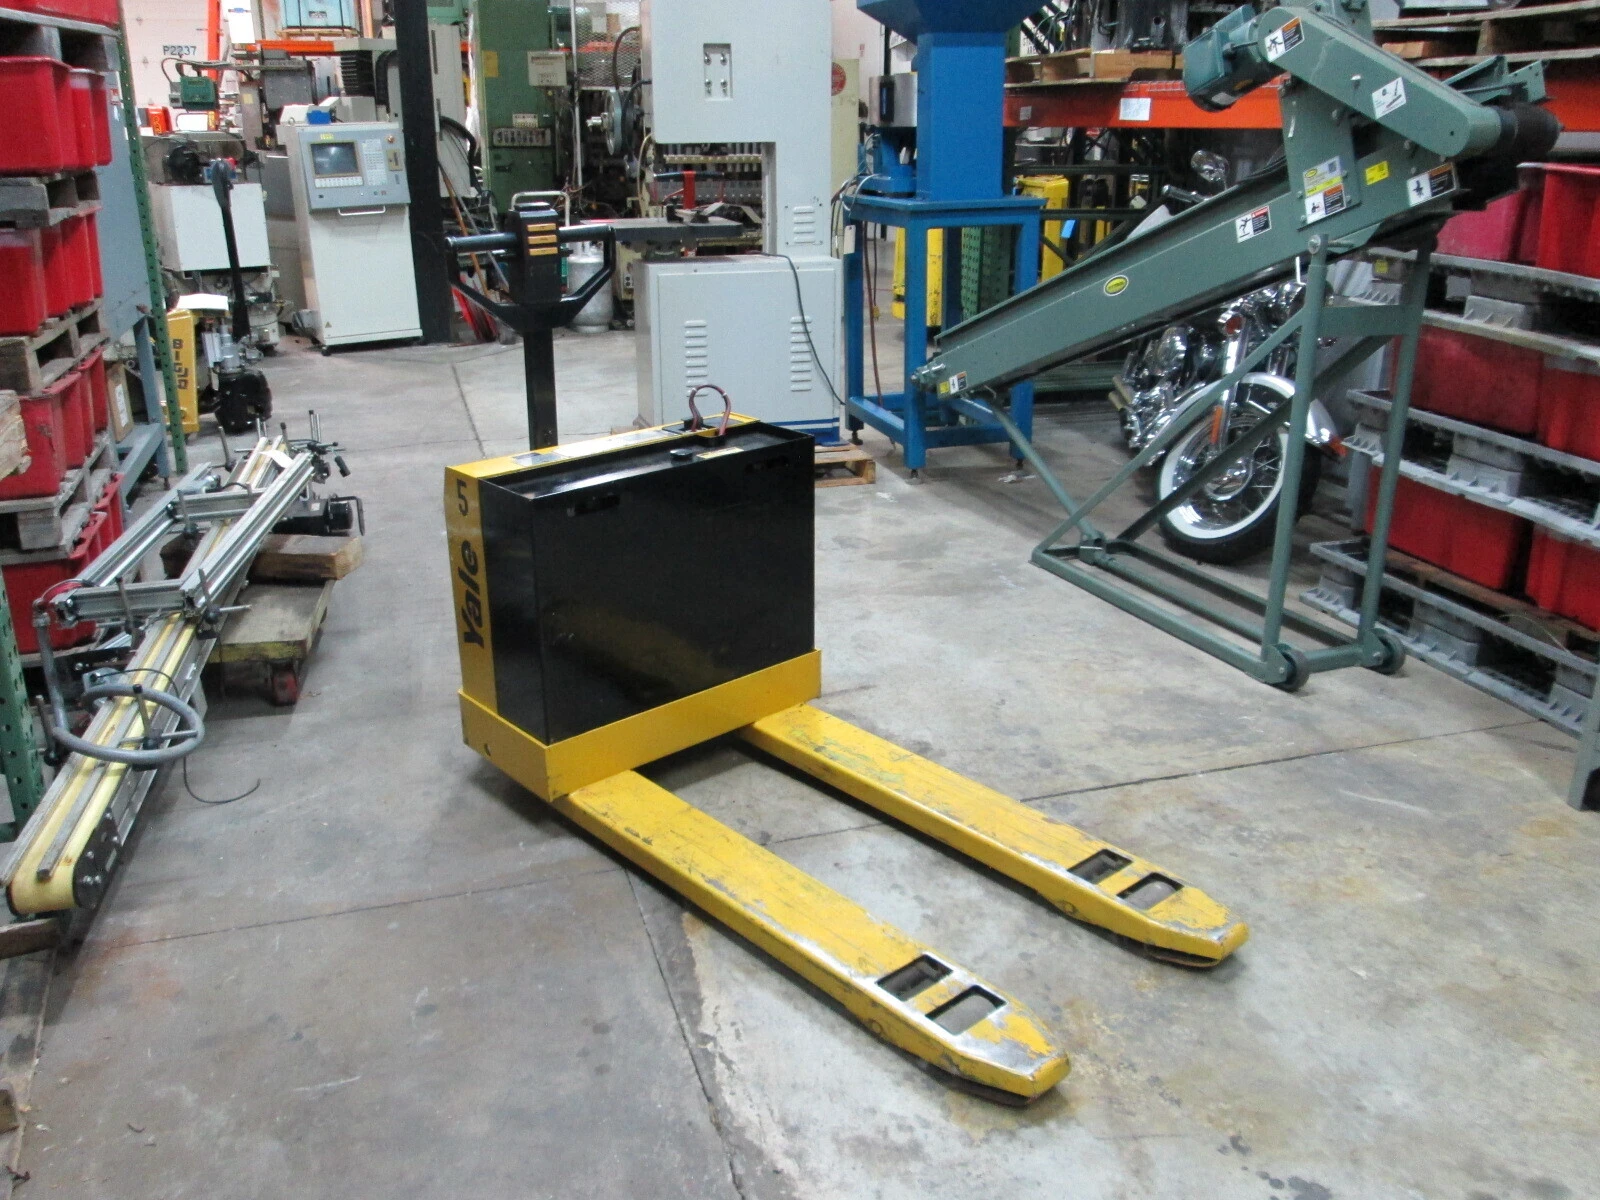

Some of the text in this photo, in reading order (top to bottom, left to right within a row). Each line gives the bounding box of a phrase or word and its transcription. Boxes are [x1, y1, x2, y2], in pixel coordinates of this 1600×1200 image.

[163, 45, 197, 56] P2237
[456, 478, 469, 517] 5
[457, 540, 485, 649] Yale
